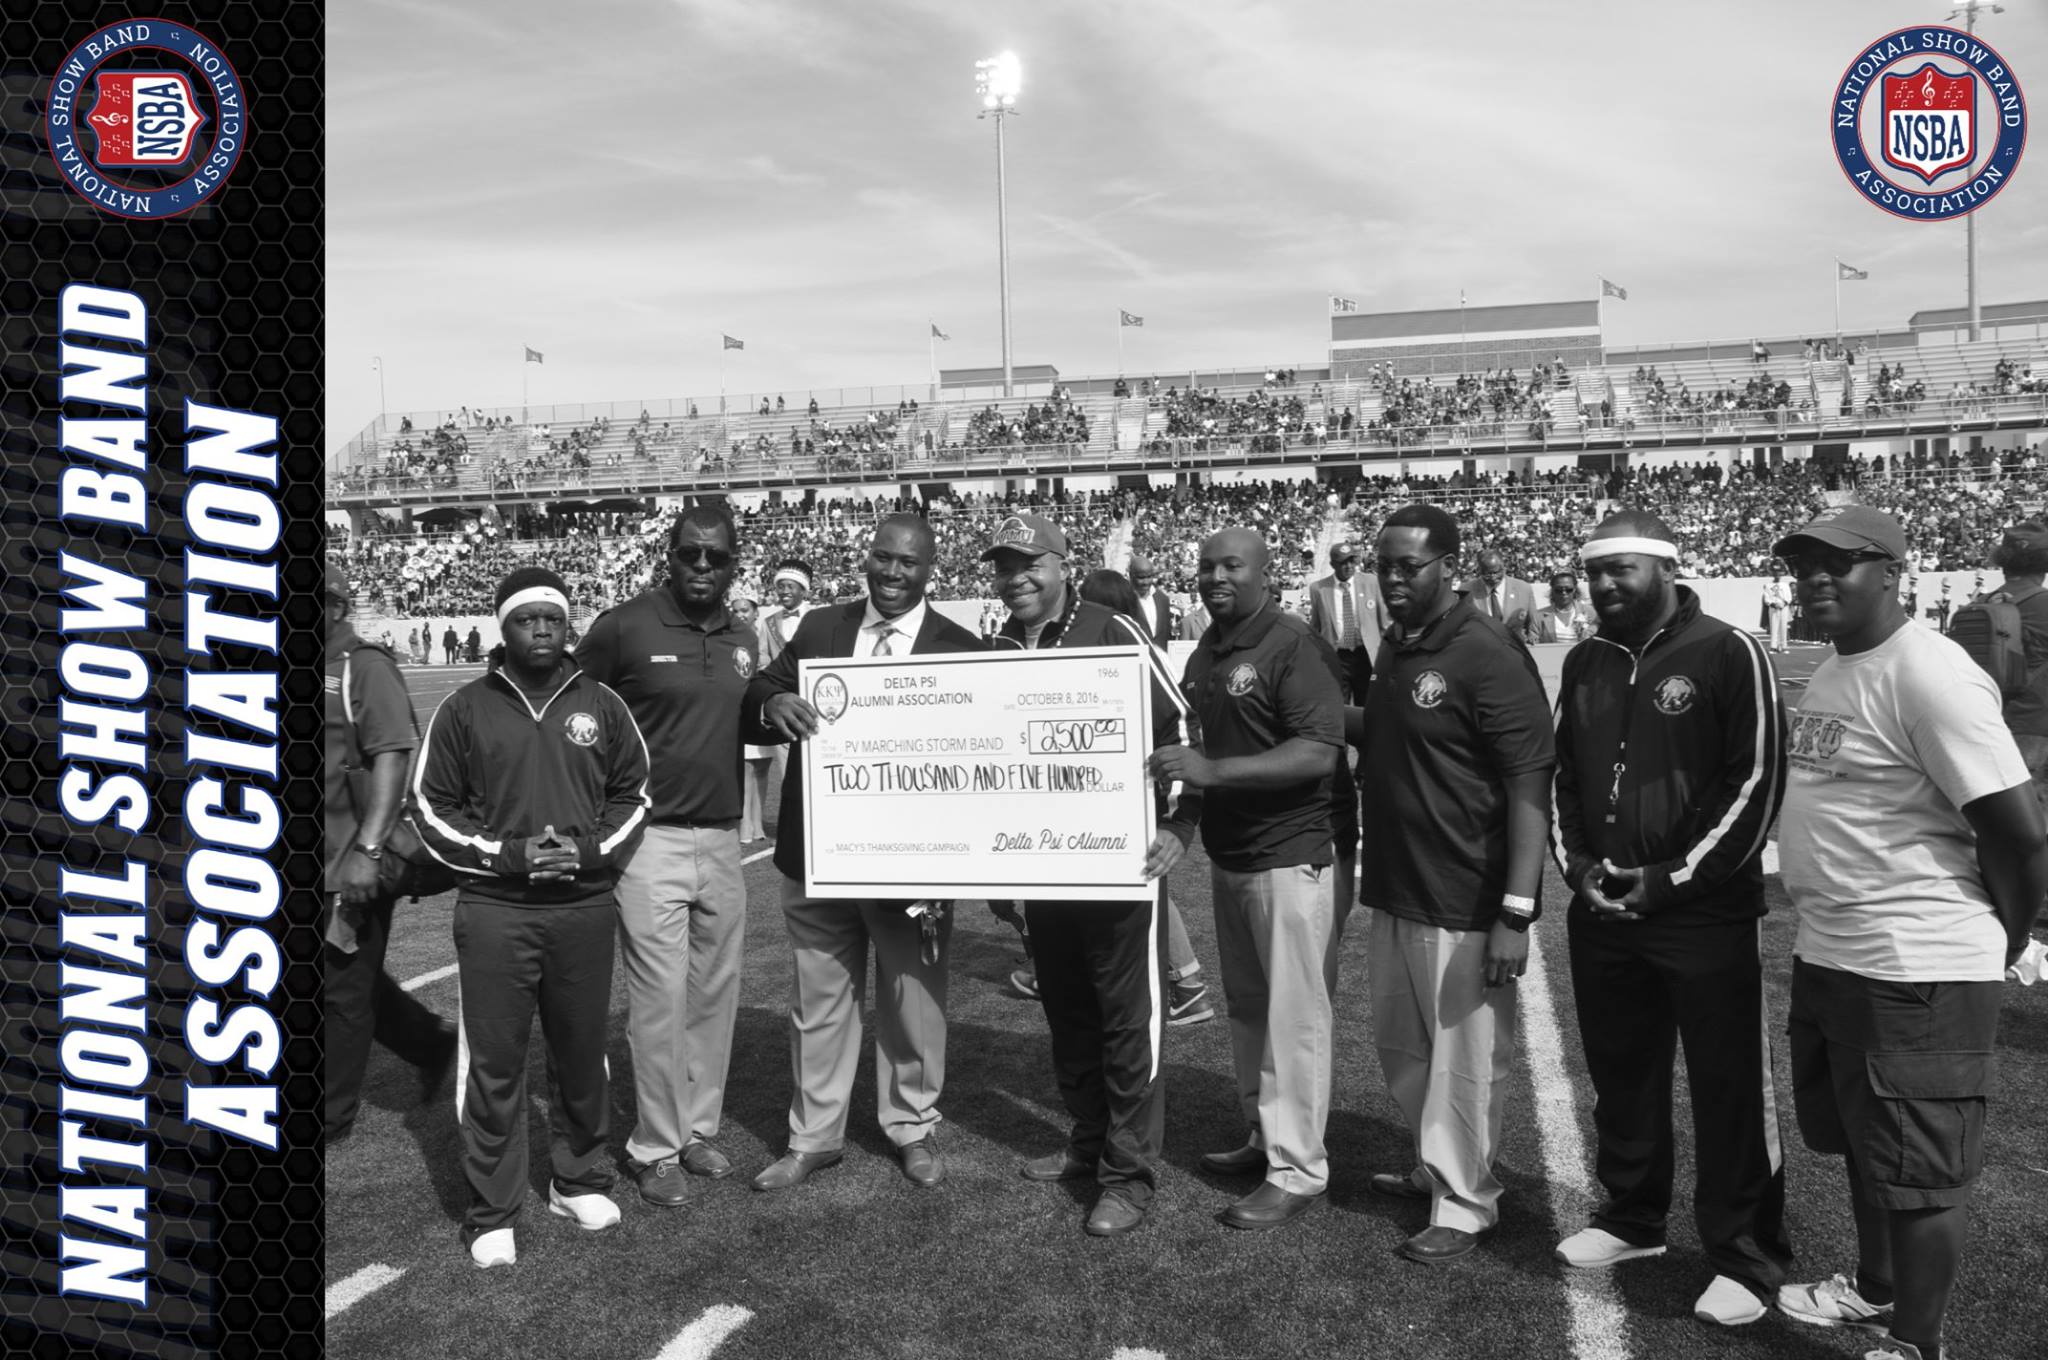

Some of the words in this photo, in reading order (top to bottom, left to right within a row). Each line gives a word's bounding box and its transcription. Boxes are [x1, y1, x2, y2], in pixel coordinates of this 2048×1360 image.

[1098, 667, 1120, 679] 1966
[883, 676, 918, 690] DELTA
[920, 675, 937, 689] PSI
[850, 695, 895, 708] ALUMNI
[897, 692, 973, 706] ASSOCIATION
[1017, 692, 1064, 706] OCTOBER
[1065, 691, 1075, 705] 8,
[1076, 691, 1099, 704] 2016
[845, 740, 859, 753] PV
[861, 738, 924, 753] MARCHING
[926, 737, 967, 752] STORM
[969, 736, 1004, 751] BAND
[1019, 731, 1028, 745] $
[823, 763, 870, 793] TWO
[871, 762, 969, 793] THOUSAND
[973, 762, 1005, 792] AND
[1008, 763, 1044, 790] FIVE
[1047, 763, 1103, 792] HUNDRED
[867, 842, 925, 852] THANKSGIVING
[927, 842, 970, 852] CAMPAIGN
[991, 831, 1034, 852] Delta
[1038, 828, 1064, 850] Psi
[1067, 831, 1129, 850] Alumni
